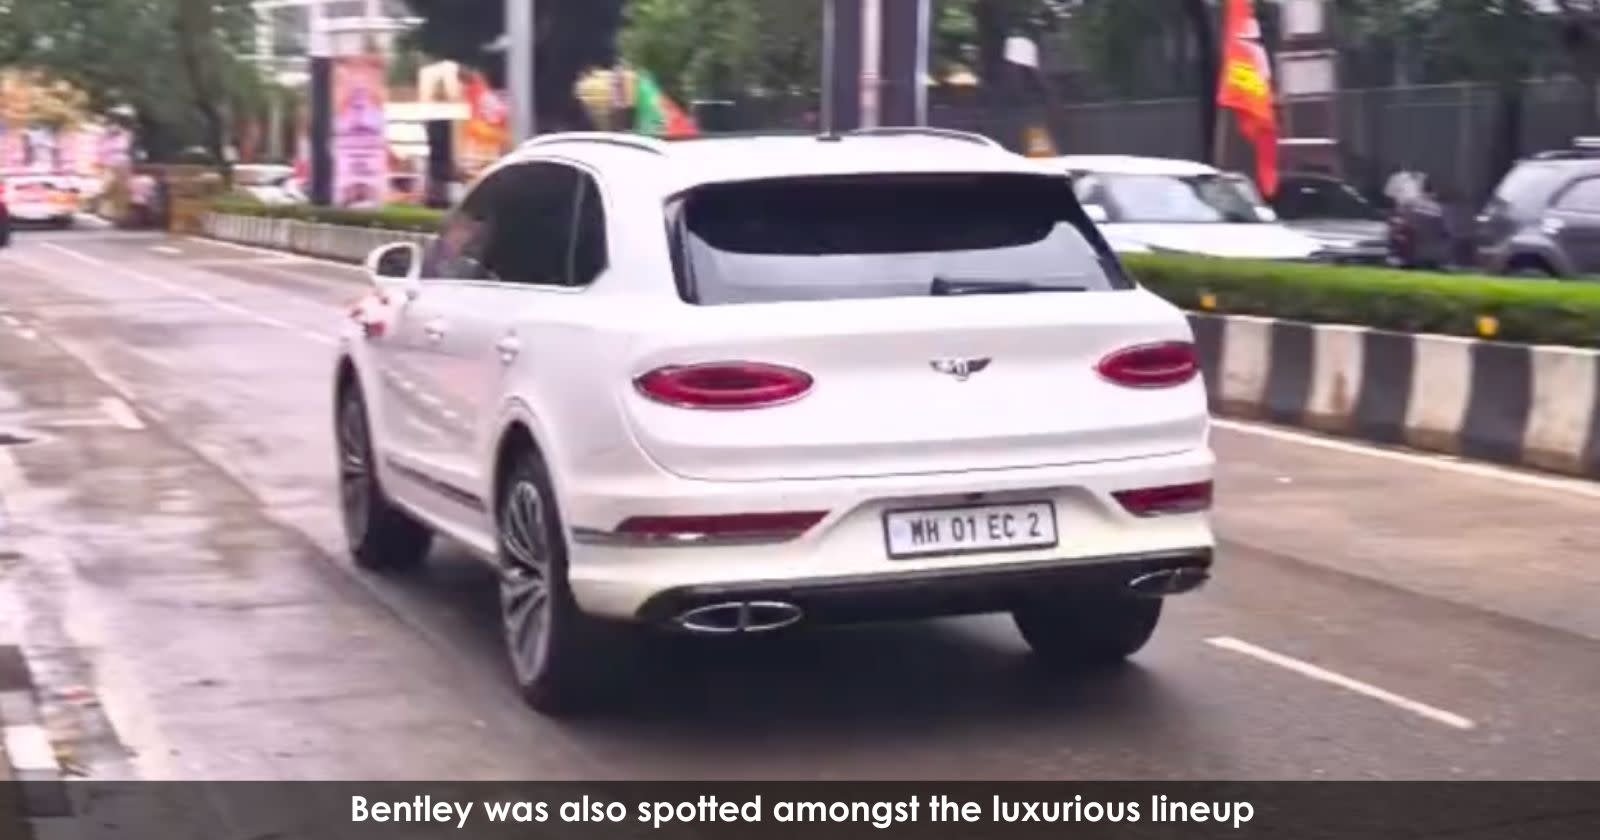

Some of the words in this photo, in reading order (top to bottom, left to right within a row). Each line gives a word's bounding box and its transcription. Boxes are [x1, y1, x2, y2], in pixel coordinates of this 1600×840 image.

[910, 518, 939, 544] MH
[951, 516, 976, 542] 01
[988, 513, 1015, 540] EC
[1027, 512, 1042, 538] 2
